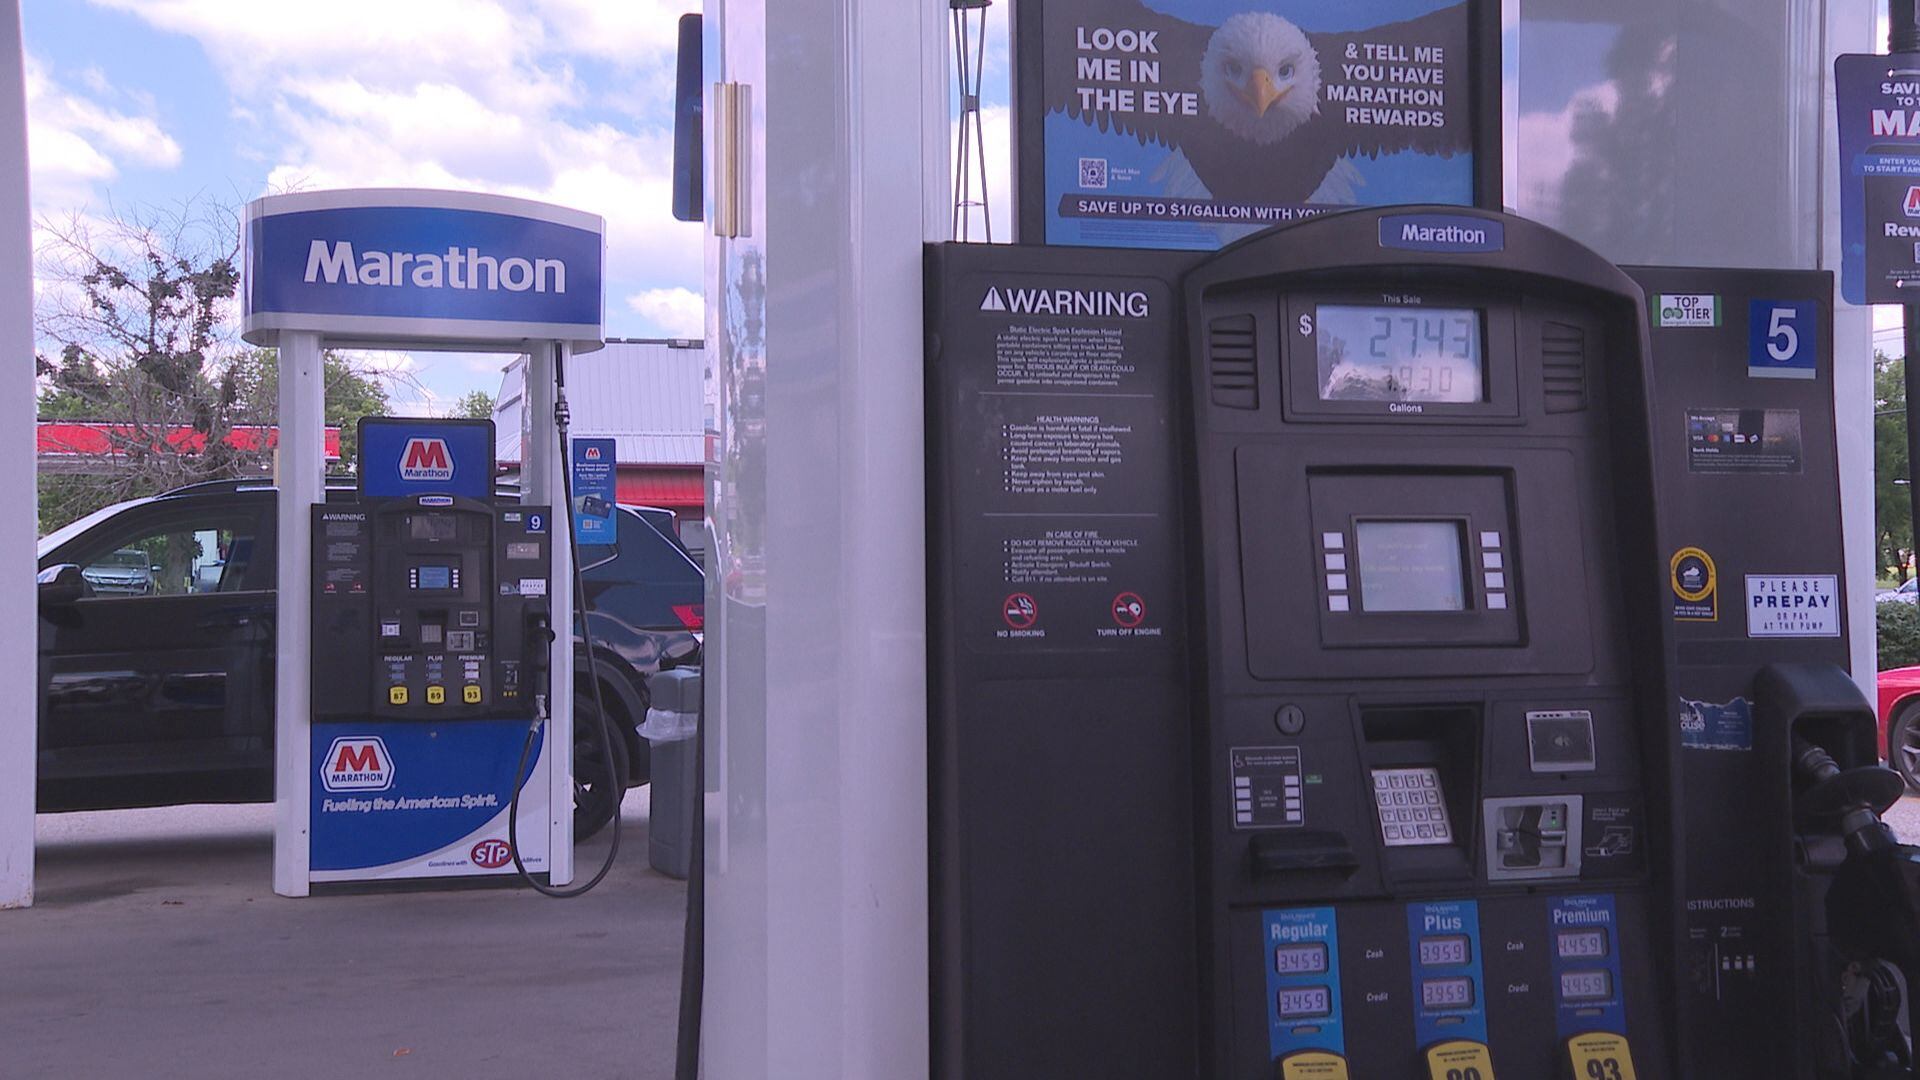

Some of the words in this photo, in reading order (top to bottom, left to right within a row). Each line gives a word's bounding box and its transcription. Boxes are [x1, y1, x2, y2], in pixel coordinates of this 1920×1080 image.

[1077, 27, 1159, 54] LOOK
[1345, 42, 1358, 59] &
[1363, 43, 1409, 61] TELL
[1414, 46, 1444, 64] ME
[1077, 57, 1121, 81] ME
[1130, 60, 1160, 83] IN
[1342, 64, 1384, 81] YOU
[1389, 66, 1444, 85] HAVE
[1077, 87, 1134, 112] THE
[1143, 90, 1198, 115] EYE
[1326, 84, 1444, 106] MARATHON
[1896, 97, 1914, 106] TO
[1345, 107, 1445, 127] REWARDS
[1078, 200, 1117, 214] SAVE
[1121, 201, 1142, 215] UP
[1146, 202, 1166, 216] TO
[1170, 203, 1251, 219] $1/GALLON
[1255, 206, 1293, 220] WITH
[1401, 223, 1485, 244] Marathon
[304, 240, 565, 293] Marathon
[1006, 288, 1148, 317] WARNING
[1383, 294, 1401, 304] This
[1402, 295, 1421, 304] Sale
[1674, 296, 1699, 308] TOP
[1684, 308, 1710, 320] TIER
[1299, 313, 1313, 337] $
[1767, 308, 1798, 361] 5
[1111, 365, 1135, 373] COULD
[1389, 403, 1423, 413] Gallons
[405, 441, 448, 468] M
[404, 468, 449, 479] Marathon
[531, 515, 541, 530] 9
[1010, 539, 1021, 547] DO
[1073, 531, 1083, 539] OF
[1760, 581, 1819, 592] PLEASE
[1753, 595, 1829, 608] PREPAY
[1777, 612, 1788, 620] OR
[1793, 612, 1808, 620] PAY
[1764, 622, 1773, 630] AT
[1779, 622, 1794, 630] THE
[1800, 622, 1823, 630] PUMP
[430, 692, 441, 700] 89
[467, 691, 478, 699] 93
[334, 745, 381, 772] M
[332, 773, 383, 783] MARATHON
[322, 798, 372, 813] Fueling
[373, 796, 393, 811] the
[397, 795, 461, 810] American
[475, 842, 508, 864] STP
[1424, 914, 1462, 930] Plus
[1553, 908, 1610, 924] Premium
[1271, 921, 1328, 942] Regular
[1507, 941, 1524, 950] Cash
[1366, 950, 1384, 959] Cash
[1508, 983, 1529, 993] Credit
[1367, 992, 1388, 1002] Credit
[1586, 1058, 1620, 1080] 93
